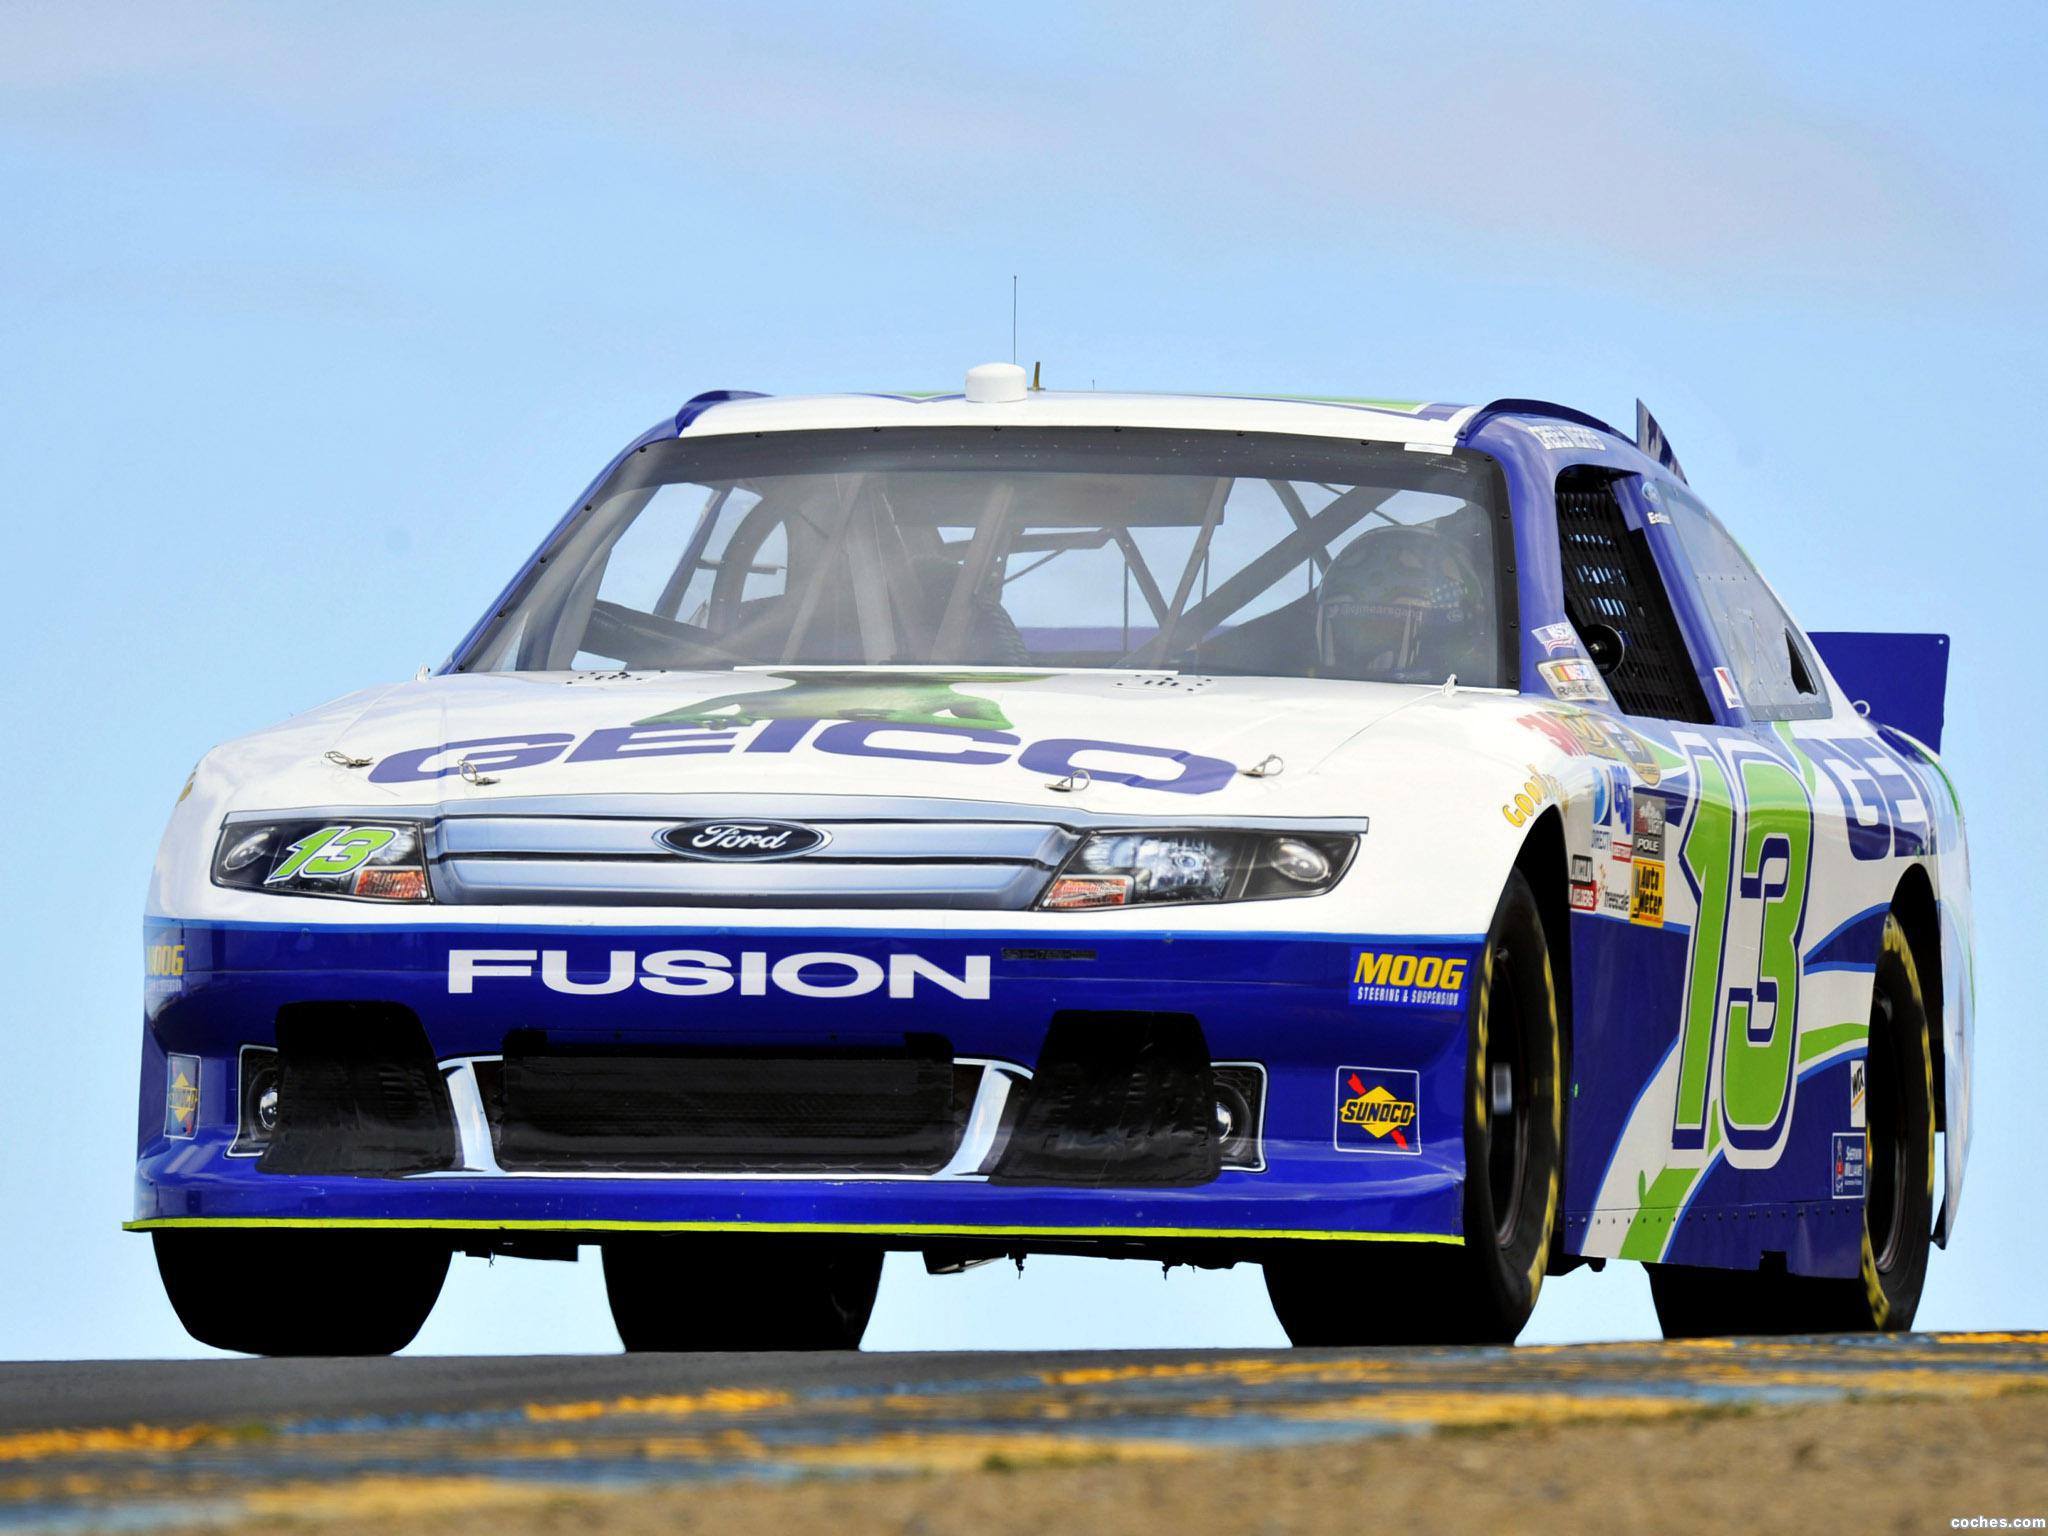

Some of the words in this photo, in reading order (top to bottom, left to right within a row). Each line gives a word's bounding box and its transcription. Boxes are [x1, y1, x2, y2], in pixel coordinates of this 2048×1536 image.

[369, 719, 1237, 795] GEICO
[692, 825, 792, 849] Ford
[1637, 838, 1660, 852] POLE
[264, 827, 399, 884] 13
[1641, 866, 1660, 890] Auto
[1639, 891, 1663, 915] Meter
[1672, 738, 1814, 1155] 13
[447, 949, 991, 1001] FUSION
[1353, 952, 1467, 990] MOOG
[1357, 986, 1400, 1002] STEERING
[1411, 989, 1459, 1006] SUSPENSION
[1344, 1101, 1414, 1124] SUNOCO
